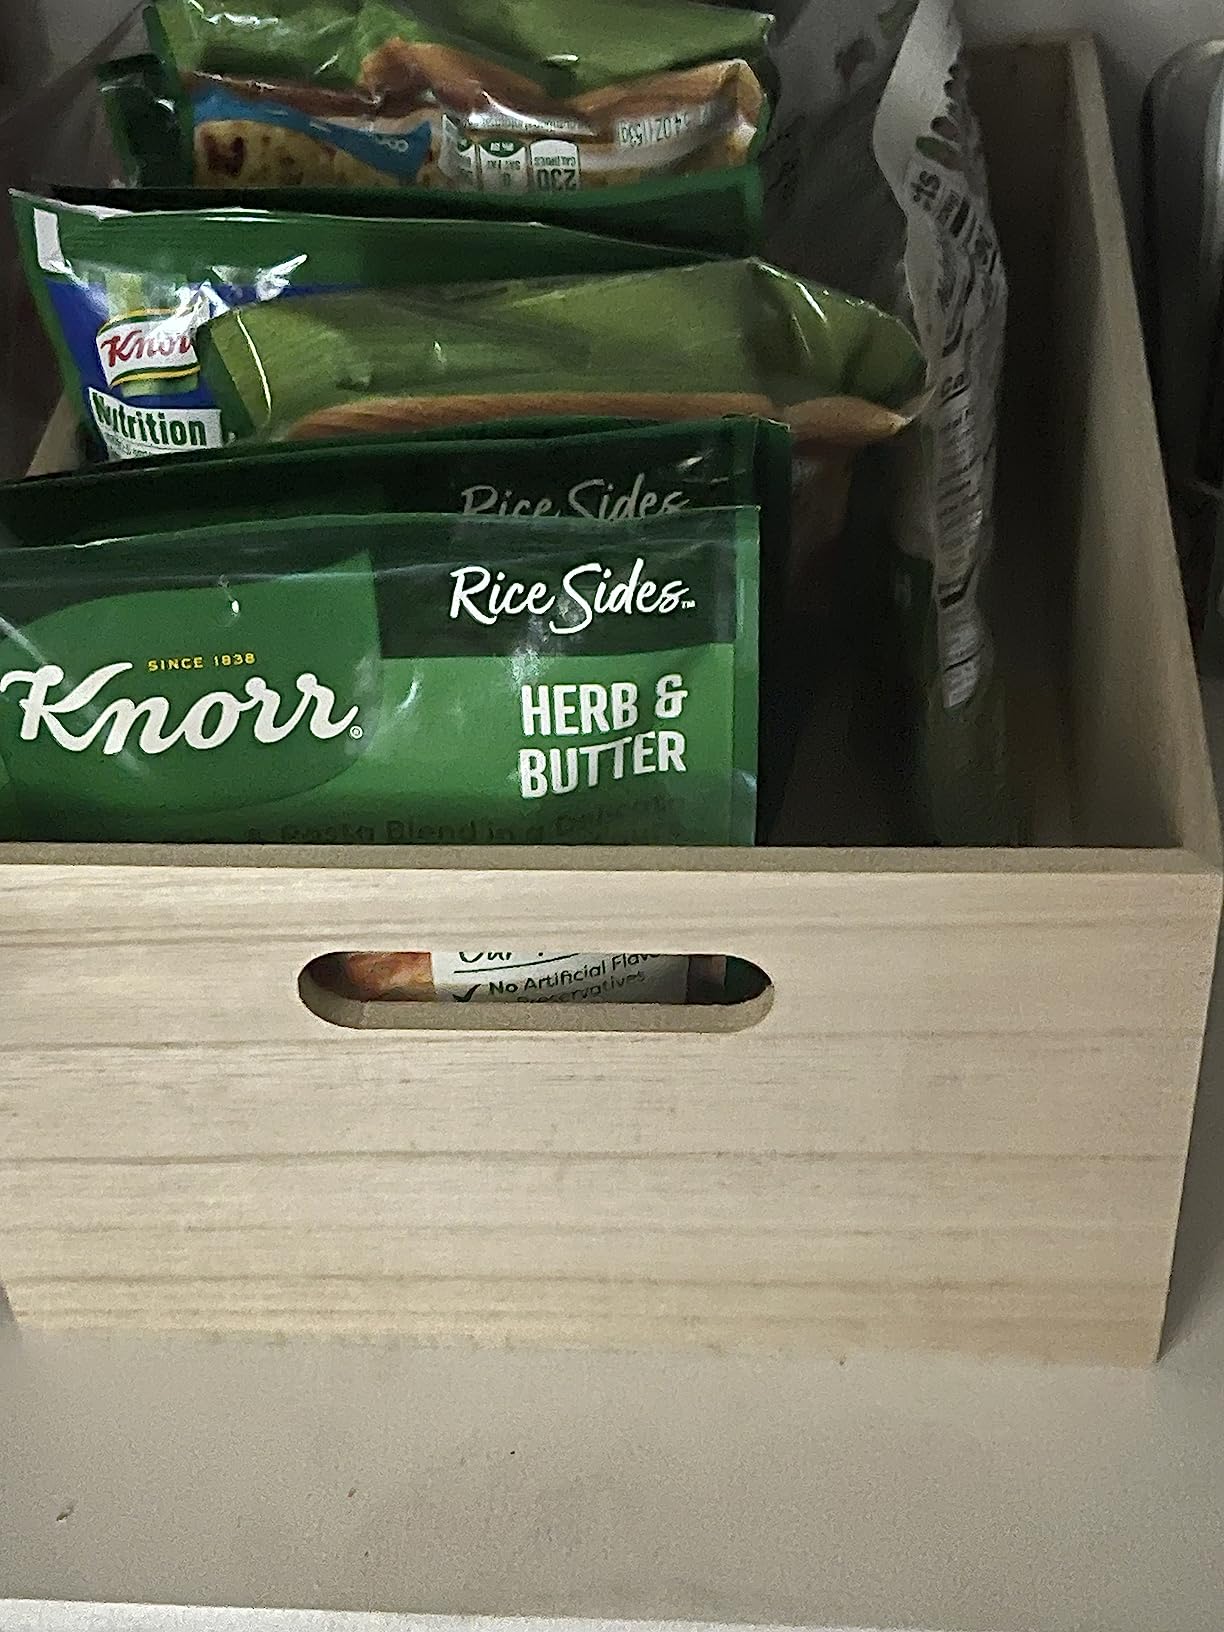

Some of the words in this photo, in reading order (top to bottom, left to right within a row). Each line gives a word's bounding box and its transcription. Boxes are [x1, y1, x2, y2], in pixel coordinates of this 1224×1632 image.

[100, 329, 192, 368] Knor
[92, 392, 207, 447] Nutrition
[450, 565, 556, 625] Rice
[147, 656, 204, 672] SINCE
[212, 652, 257, 667] 1838
[521, 681, 640, 736] HERB
[655, 673, 689, 719] &
[519, 730, 687, 799] BUTTER
[489, 980, 519, 995] No
[524, 959, 606, 992] Artificial
[612, 952, 662, 971] Flav
